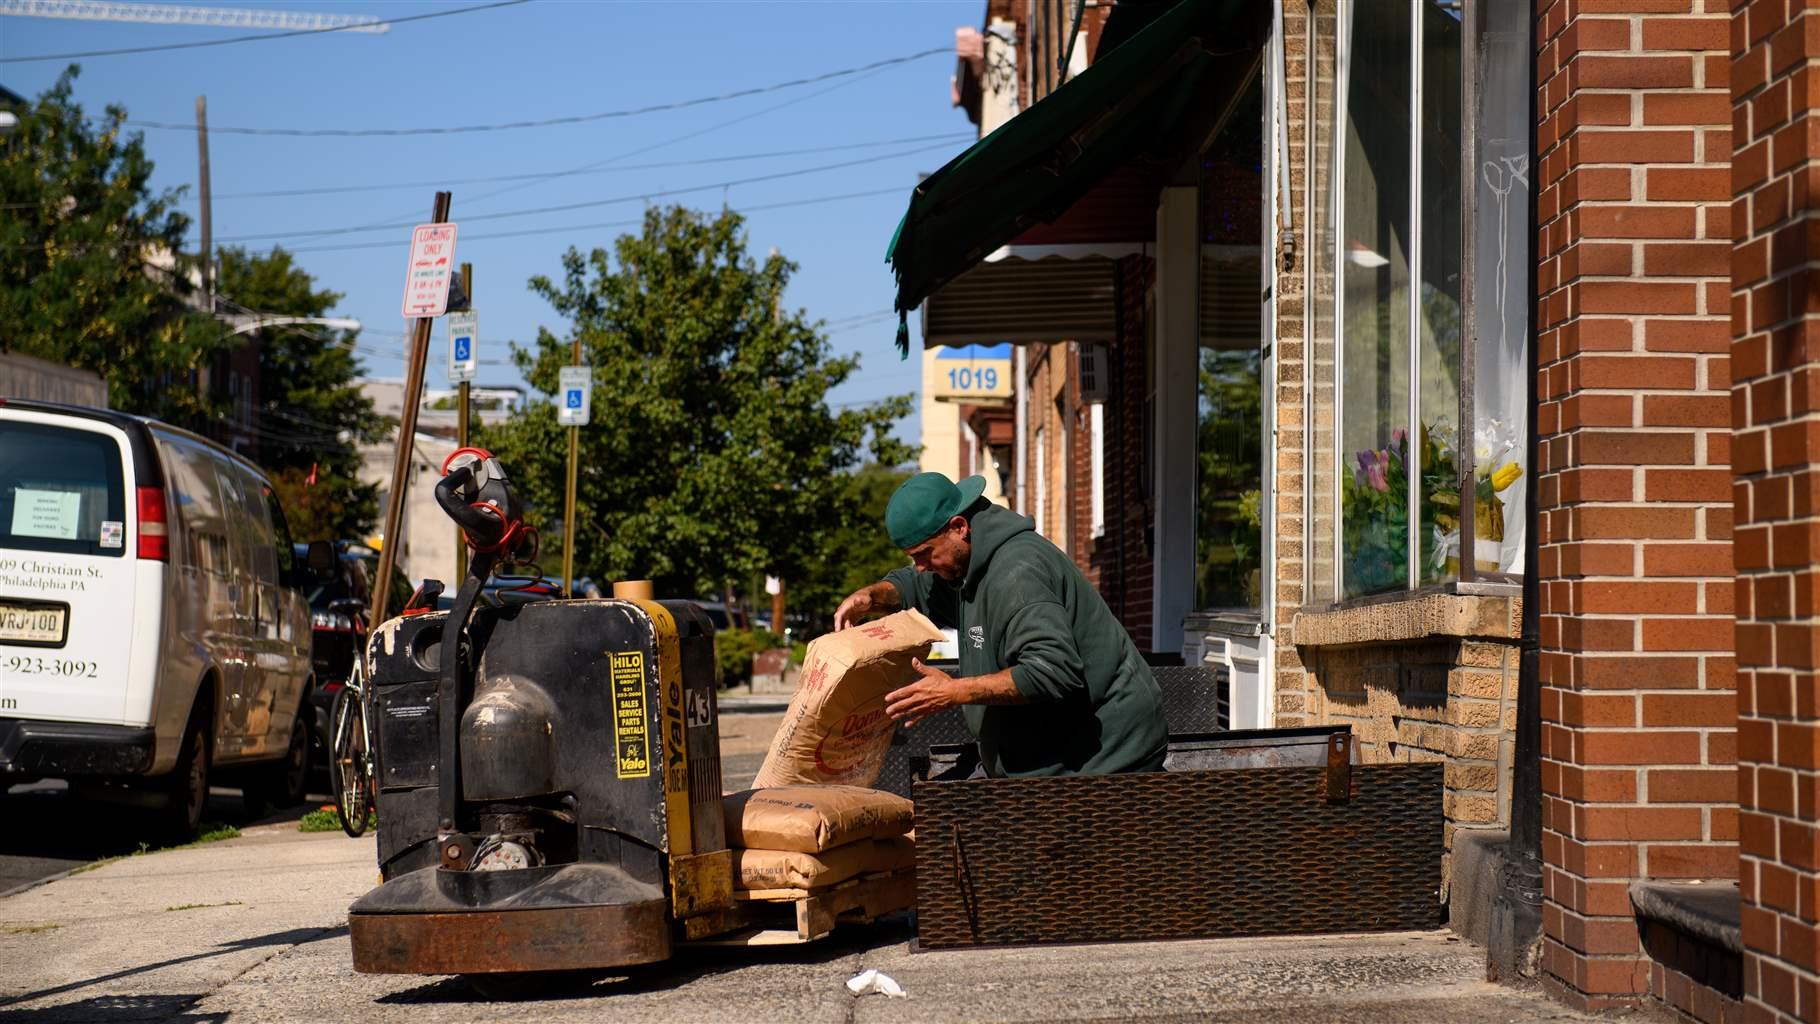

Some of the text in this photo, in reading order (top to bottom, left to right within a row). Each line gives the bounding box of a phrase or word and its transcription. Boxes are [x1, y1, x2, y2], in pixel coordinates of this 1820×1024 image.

[423, 243, 443, 255] ONLY
[948, 367, 997, 390] 1019
[21, 560, 82, 577] Christian
[87, 567, 104, 579] St.
[0, 575, 86, 592] Philadelphia PA
[0, 655, 98, 679] -923-3092
[614, 656, 640, 668] HILO
[620, 700, 639, 709] SALES
[687, 688, 710, 726] 43
[618, 708, 643, 718] SERVICE
[621, 717, 641, 726] PARTS
[666, 680, 684, 769] Yale
[619, 726, 645, 736] RENTALS
[620, 757, 646, 770] Yale
